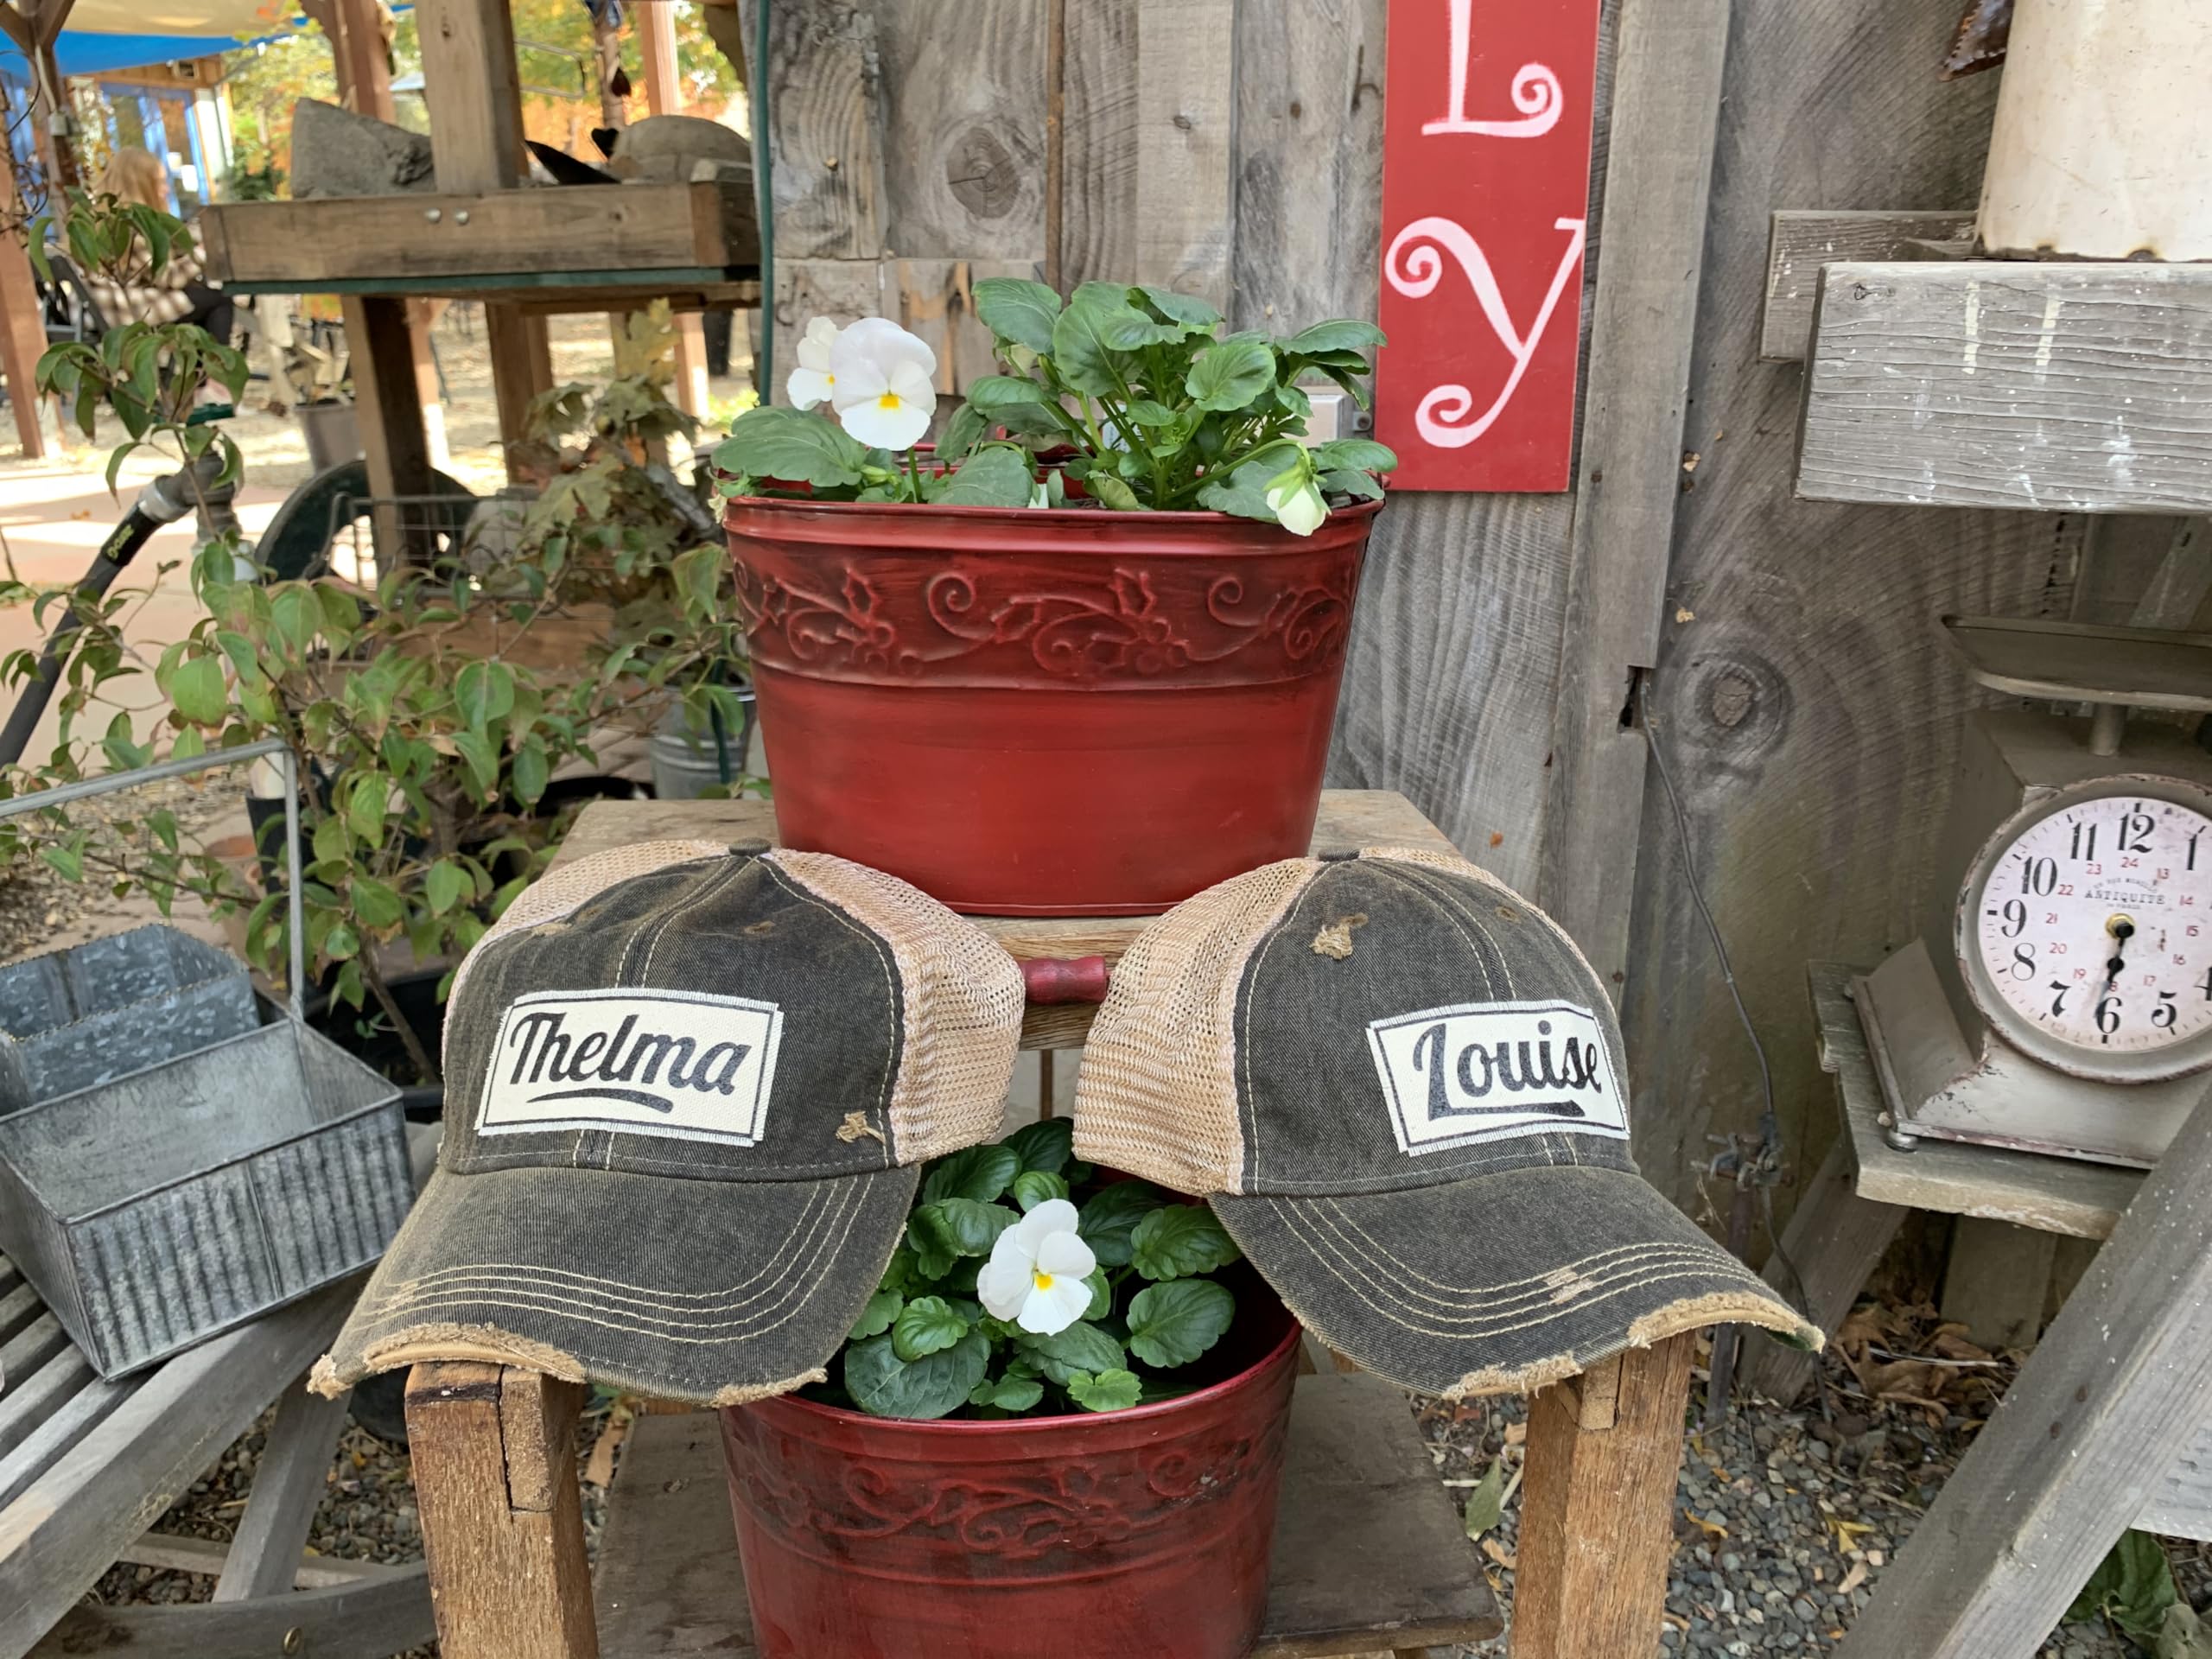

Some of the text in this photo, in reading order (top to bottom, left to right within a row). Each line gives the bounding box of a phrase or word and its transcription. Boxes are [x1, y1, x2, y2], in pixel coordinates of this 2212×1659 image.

[2070, 822, 2097, 861] 11
[2117, 813, 2155, 854] 12
[2085, 863, 2102, 874] 23
[2121, 856, 2139, 868] 24
[2187, 834, 2197, 871] 1
[2021, 856, 2058, 897] 10
[2057, 883, 2074, 896] 22
[2157, 868, 2170, 880] 13
[2001, 899, 2027, 938] 9
[2045, 912, 2058, 925] 21
[2179, 894, 2194, 906] 14
[2049, 942, 2068, 955] 20
[2186, 925, 2199, 938] 15
[2011, 942, 2036, 982] 8
[2074, 968, 2087, 980] 19
[2172, 953, 2187, 966] 16
[2049, 980, 2072, 1018] 7
[2095, 996, 2123, 1034] 6
[2151, 991, 2177, 1028] 5
[509, 1011, 753, 1096] Thelma
[1413, 1020, 1602, 1122] Louise
